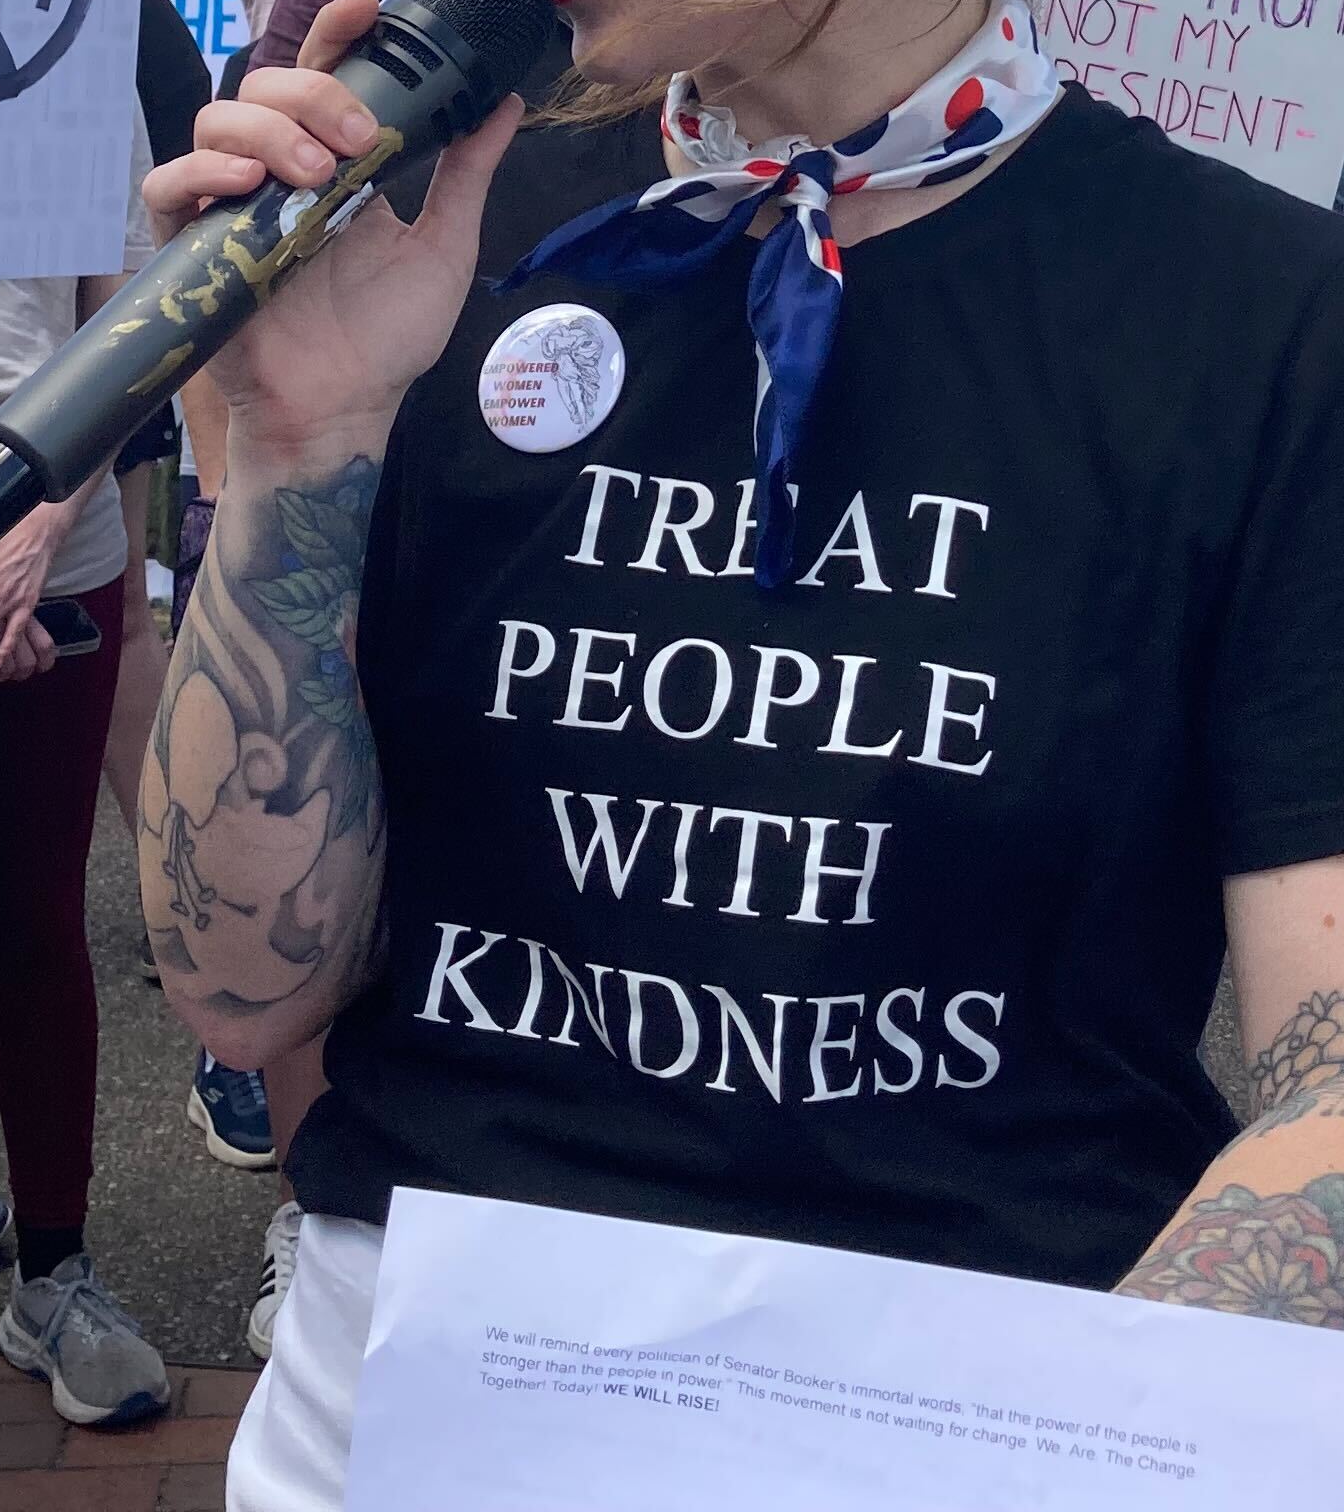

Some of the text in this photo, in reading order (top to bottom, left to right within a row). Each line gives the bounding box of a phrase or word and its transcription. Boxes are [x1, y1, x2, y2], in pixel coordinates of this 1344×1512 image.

[1173, 13, 1251, 73] MY
[484, 362, 559, 375] EMPOWERED
[493, 380, 542, 392] WOMEN
[483, 397, 545, 410] EMPOWER
[488, 415, 536, 427] WOMEN
[484, 619, 997, 776] PEOPLE
[545, 787, 893, 925] WITH
[413, 922, 1005, 1105] KINDNESS
[481, 1350, 541, 1372] stronger
[545, 1359, 576, 1376] than
[581, 1363, 604, 1377] the
[607, 1367, 657, 1382] people
[660, 1368, 674, 1382] in
[737, 1380, 766, 1400] This
[770, 1390, 846, 1417] movement
[849, 1405, 862, 1420] is
[866, 1409, 890, 1425] not
[893, 1414, 944, 1437] waiting
[949, 1422, 968, 1438] for
[1105, 1449, 1133, 1467] The
[485, 1325, 509, 1342] We
[513, 1332, 536, 1347] will
[540, 1336, 589, 1355] remind
[593, 1345, 633, 1362] every
[637, 1350, 701, 1365] politician
[705, 1353, 721, 1367] of
[723, 1355, 782, 1379] Senator
[851, 1385, 914, 1405] immortal
[1008, 1409, 1031, 1427] the
[1035, 1416, 1082, 1435] power
[1084, 1423, 1102, 1438] of
[1104, 1426, 1127, 1442] the
[1131, 1432, 1181, 1452] people
[1184, 1442, 1197, 1455] is
[603, 1382, 629, 1396] WE
[633, 1385, 672, 1405] WILL
[677, 1392, 720, 1412] RISE!
